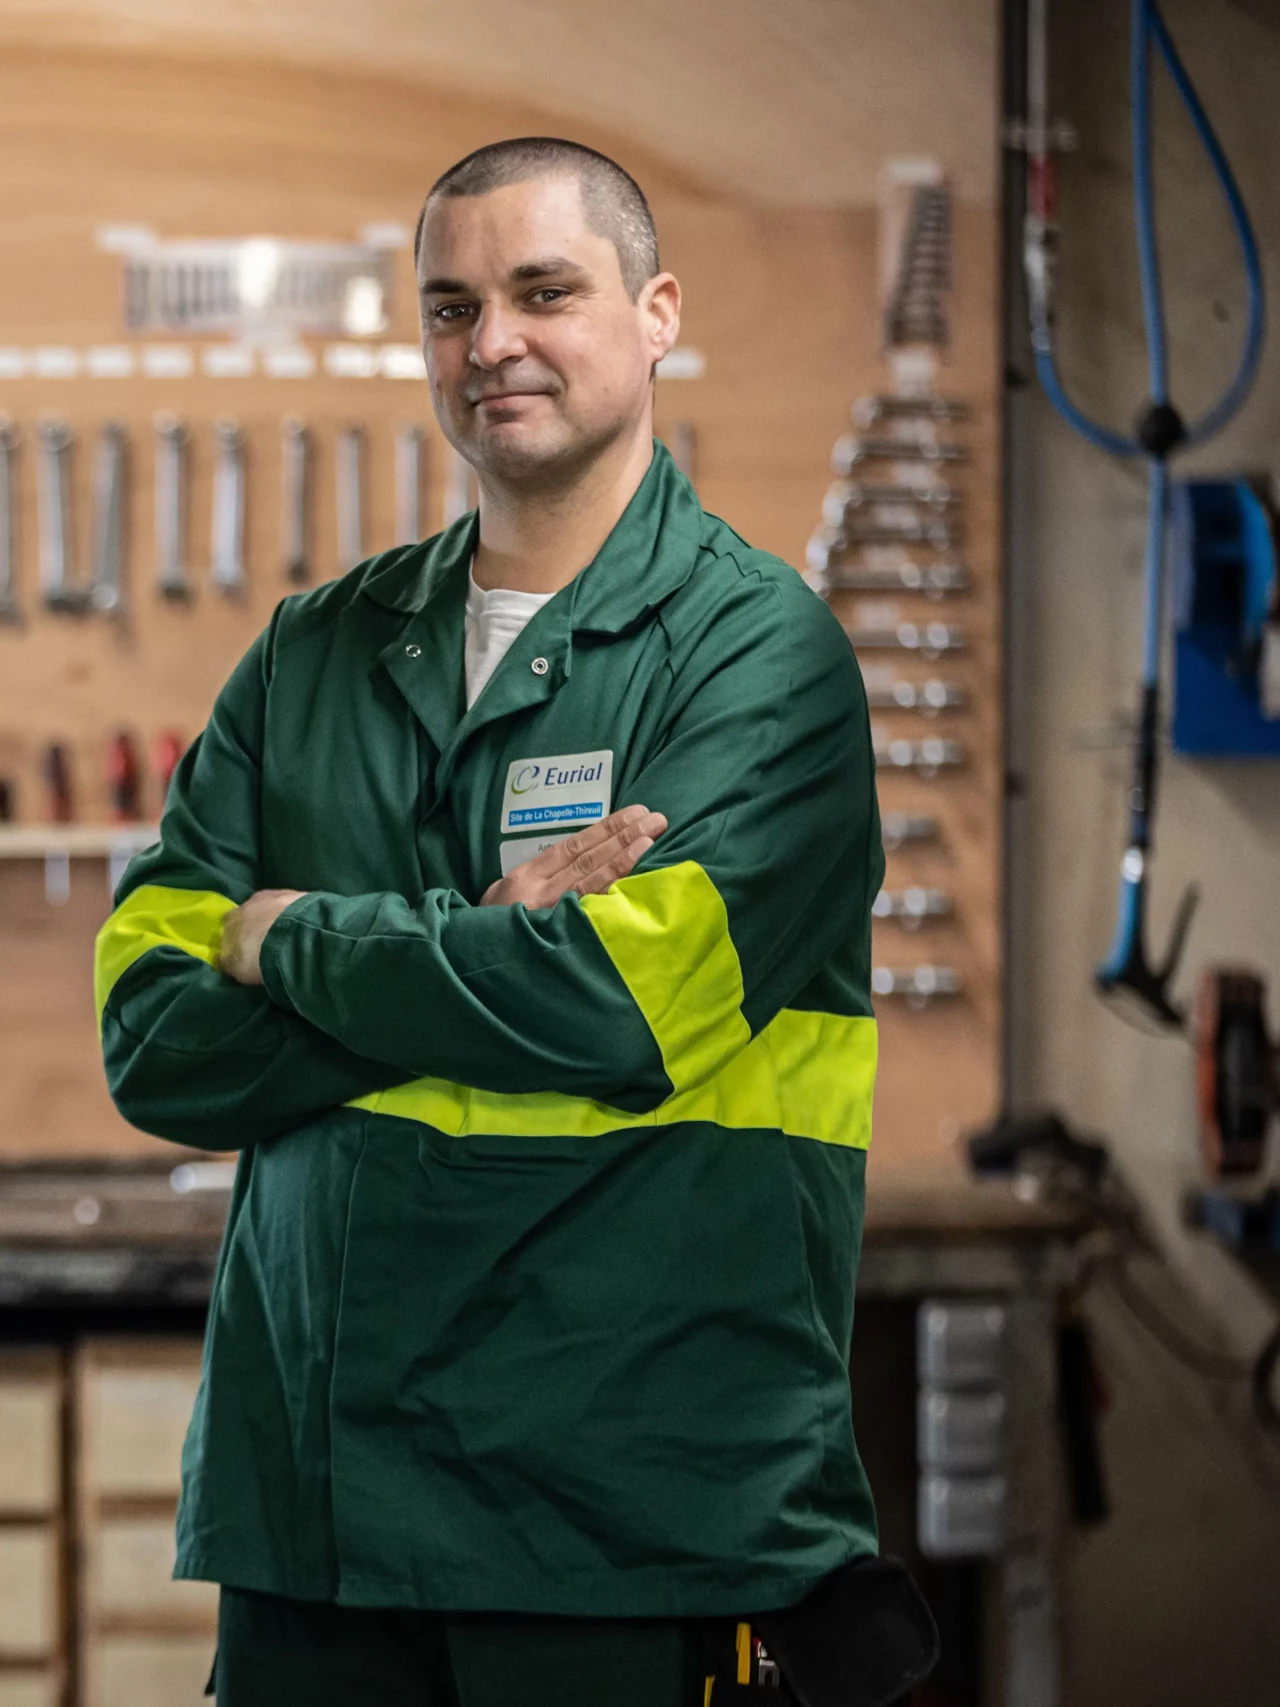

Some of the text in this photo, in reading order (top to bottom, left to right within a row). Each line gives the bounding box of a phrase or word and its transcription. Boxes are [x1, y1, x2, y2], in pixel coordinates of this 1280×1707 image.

[544, 762, 603, 786] Eurial
[510, 812, 523, 823] Site
[524, 812, 533, 821] de
[534, 811, 542, 820] La
